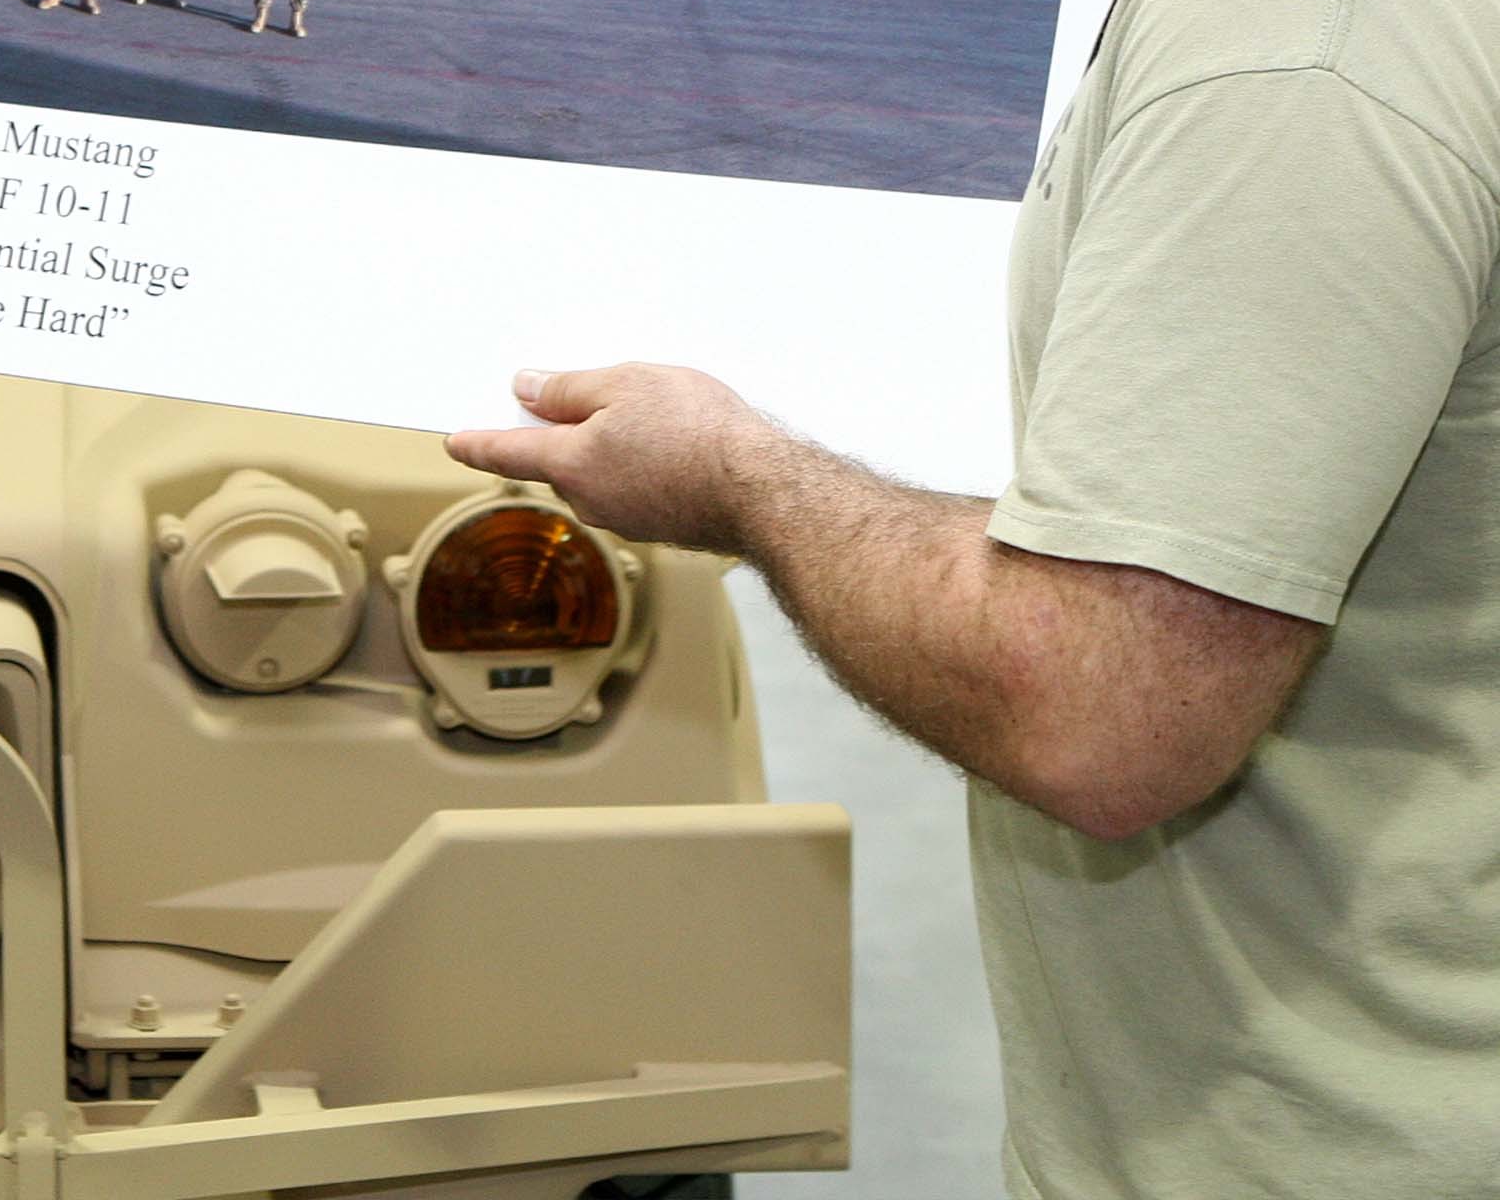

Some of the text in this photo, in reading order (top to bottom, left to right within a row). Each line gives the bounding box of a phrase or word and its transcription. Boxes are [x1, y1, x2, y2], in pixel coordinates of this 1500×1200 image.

[2, 121, 159, 179] Mustang
[38, 183, 132, 225] 10-11
[85, 246, 190, 296] Surge
[17, 296, 130, 339] Hard”
